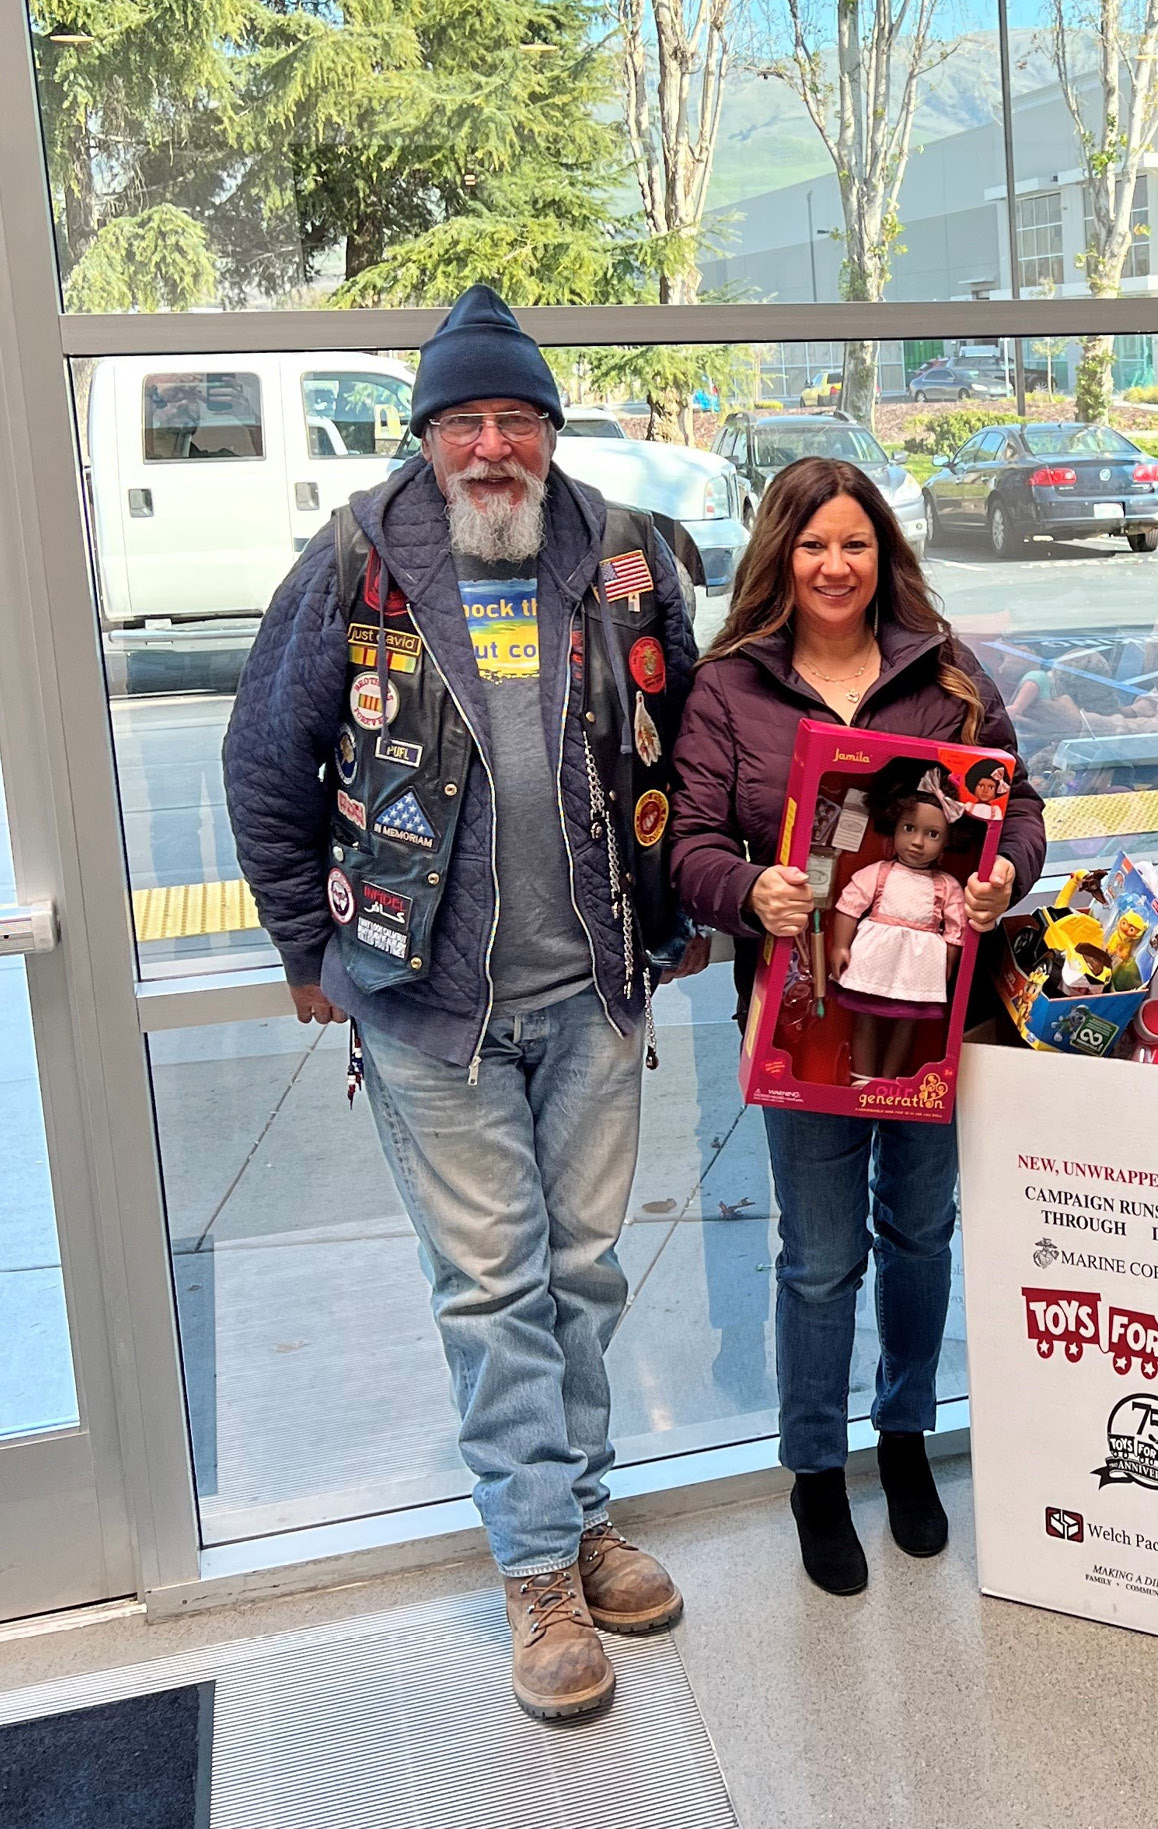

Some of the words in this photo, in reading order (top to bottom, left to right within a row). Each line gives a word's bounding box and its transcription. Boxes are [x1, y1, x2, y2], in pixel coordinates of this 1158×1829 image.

[351, 627, 374, 641] just
[377, 634, 416, 649] avid
[832, 748, 870, 764] Jamila
[374, 823, 381, 834] IN
[383, 826, 433, 848] MEMORIAM
[859, 1091, 944, 1110] generation
[876, 1086, 913, 1098] our
[1018, 1154, 1059, 1176] NEW,
[1025, 1186, 1115, 1213] CAMPAIGN
[1041, 1209, 1127, 1236] THROUGH
[1061, 1251, 1126, 1274] MARINE
[1028, 1299, 1096, 1338] TOYS
[1109, 1438, 1133, 1452] TOYS
[1138, 1443, 1157, 1458] FOR
[1087, 1523, 1131, 1545] Welch
[1085, 1573, 1112, 1586] FAMILY
[1092, 1564, 1134, 1582] MAKING
[1135, 1575, 1143, 1584] A
